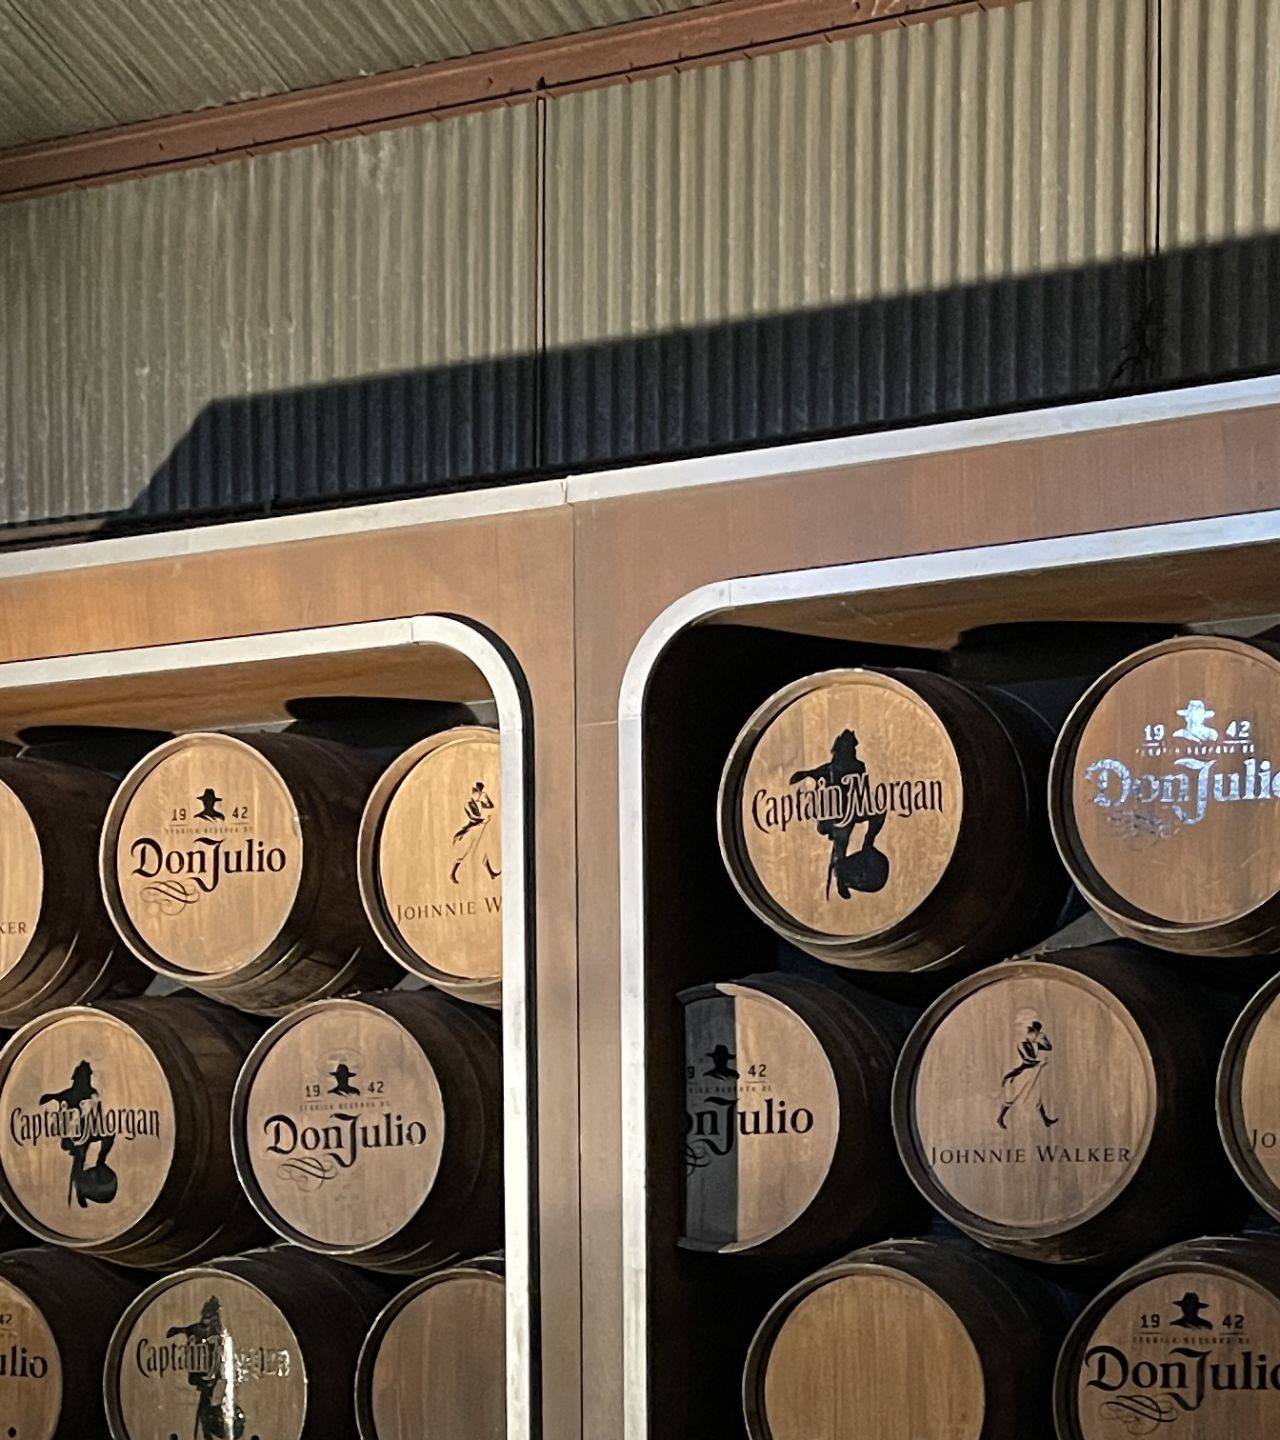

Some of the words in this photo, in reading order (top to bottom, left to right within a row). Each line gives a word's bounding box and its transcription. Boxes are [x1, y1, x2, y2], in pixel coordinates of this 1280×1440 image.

[1144, 724, 1165, 741] 19
[1225, 720, 1251, 737] 42
[752, 776, 843, 834] Captain
[833, 772, 943, 829] Morgan
[170, 808, 187, 822] 19
[232, 806, 249, 819] 42
[396, 902, 477, 925] JOHNNIE
[747, 1063, 767, 1078] 42
[304, 1085, 321, 1098] 19
[367, 1081, 385, 1093] 42
[10, 1101, 81, 1147] Captain
[74, 1100, 160, 1145] Morgan
[931, 1146, 1027, 1166] JOHNNIE
[1036, 1145, 1132, 1164] WALKER
[1140, 1314, 1161, 1328] 19
[1222, 1314, 1245, 1329] 42
[136, 1335, 210, 1379] Captain
